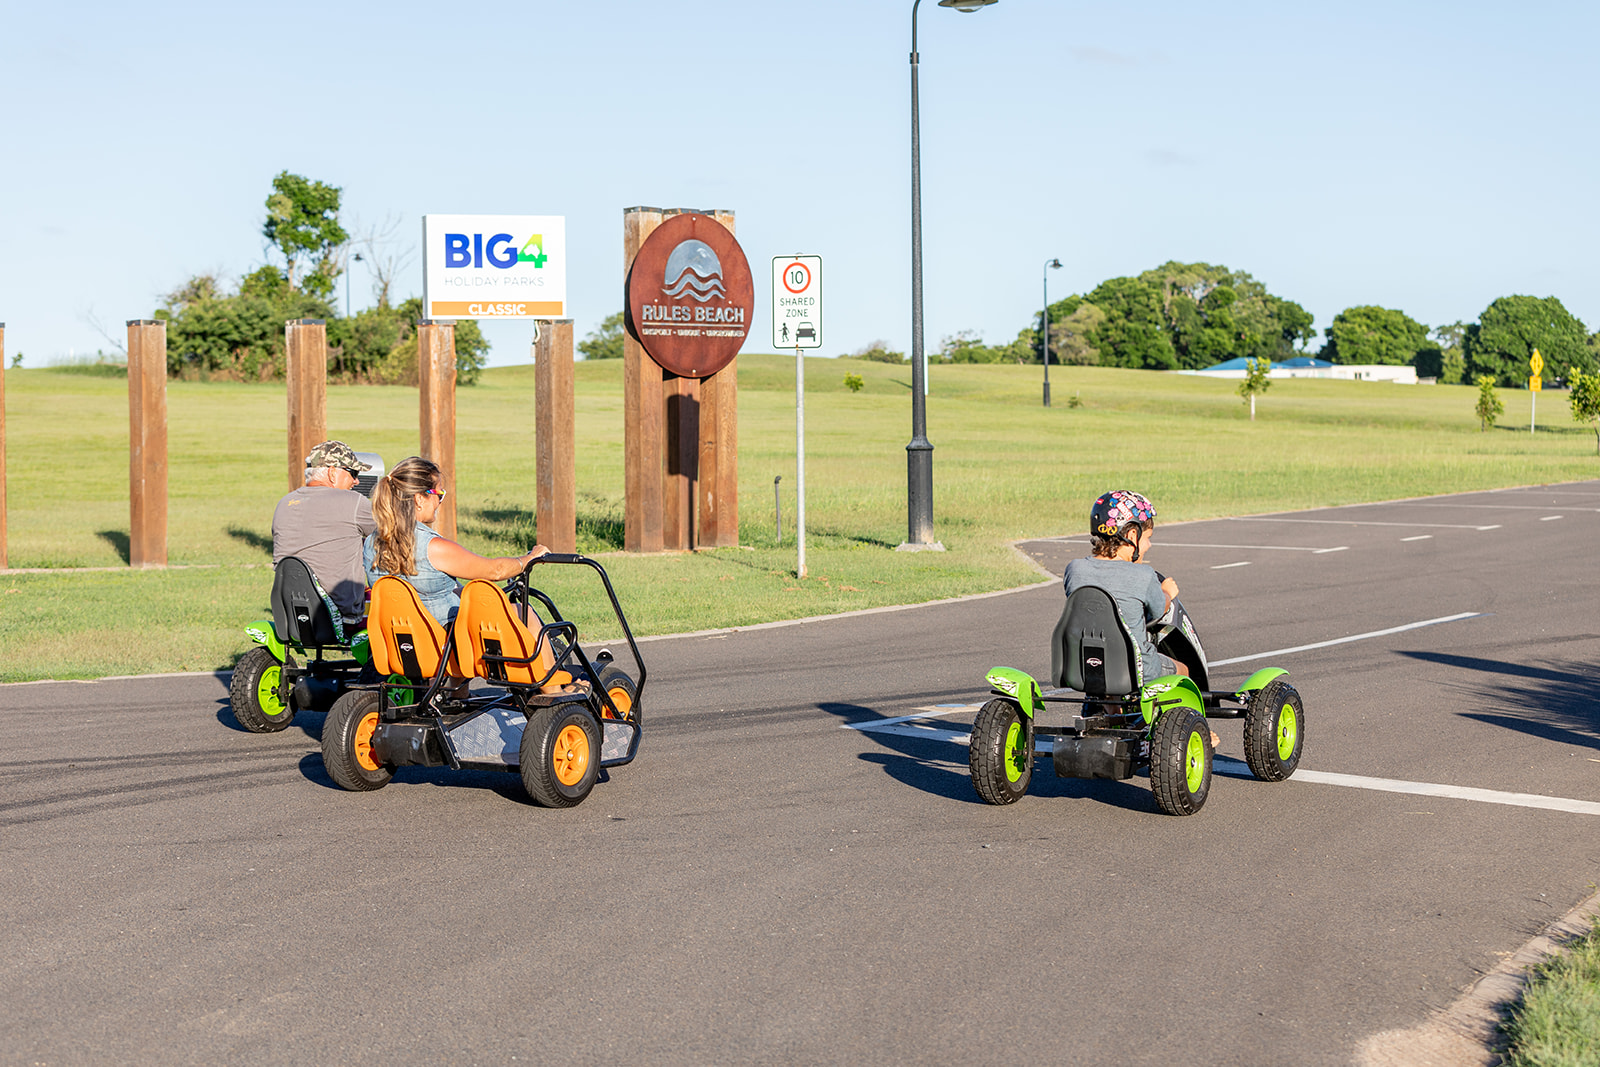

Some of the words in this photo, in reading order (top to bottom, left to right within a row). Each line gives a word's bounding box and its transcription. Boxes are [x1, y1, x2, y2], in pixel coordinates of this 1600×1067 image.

[445, 233, 547, 269] BIG4
[445, 277, 499, 287] HOLIDAY
[504, 277, 544, 287] PARKS
[791, 271, 803, 284] 10
[780, 297, 815, 306] SHARED
[468, 304, 526, 315] CLASSIC
[642, 305, 691, 322] RULES
[695, 307, 744, 323] BEACH
[786, 309, 808, 317] ZONE
